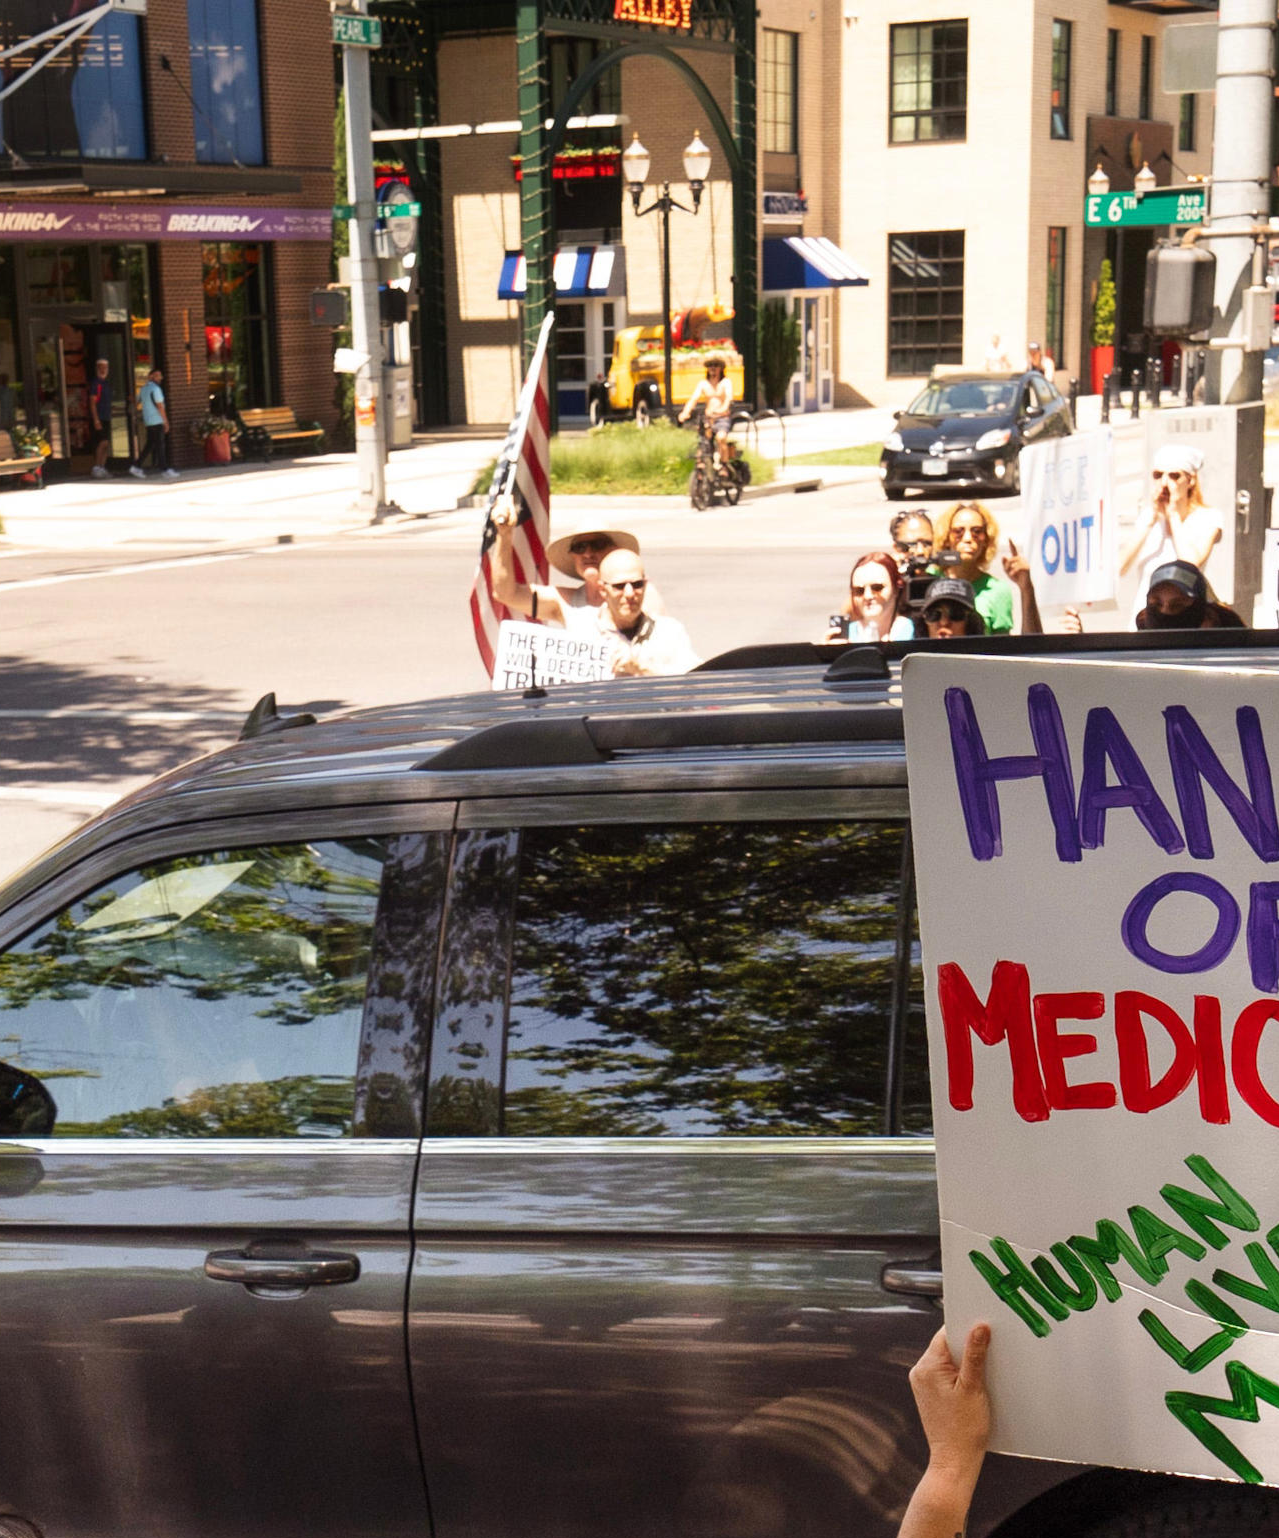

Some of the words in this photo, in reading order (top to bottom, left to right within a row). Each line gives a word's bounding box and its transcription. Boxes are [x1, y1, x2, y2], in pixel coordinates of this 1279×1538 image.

[335, 18, 367, 42] PEARL
[1087, 197, 1101, 222] E
[1108, 196, 1137, 222] 6TH
[167, 214, 250, 233] BREAKING4
[508, 631, 538, 651] THE
[544, 638, 609, 662] PEOPLE
[547, 657, 605, 681] DEFEAT
[968, 1153, 1260, 1340] HUMAN
